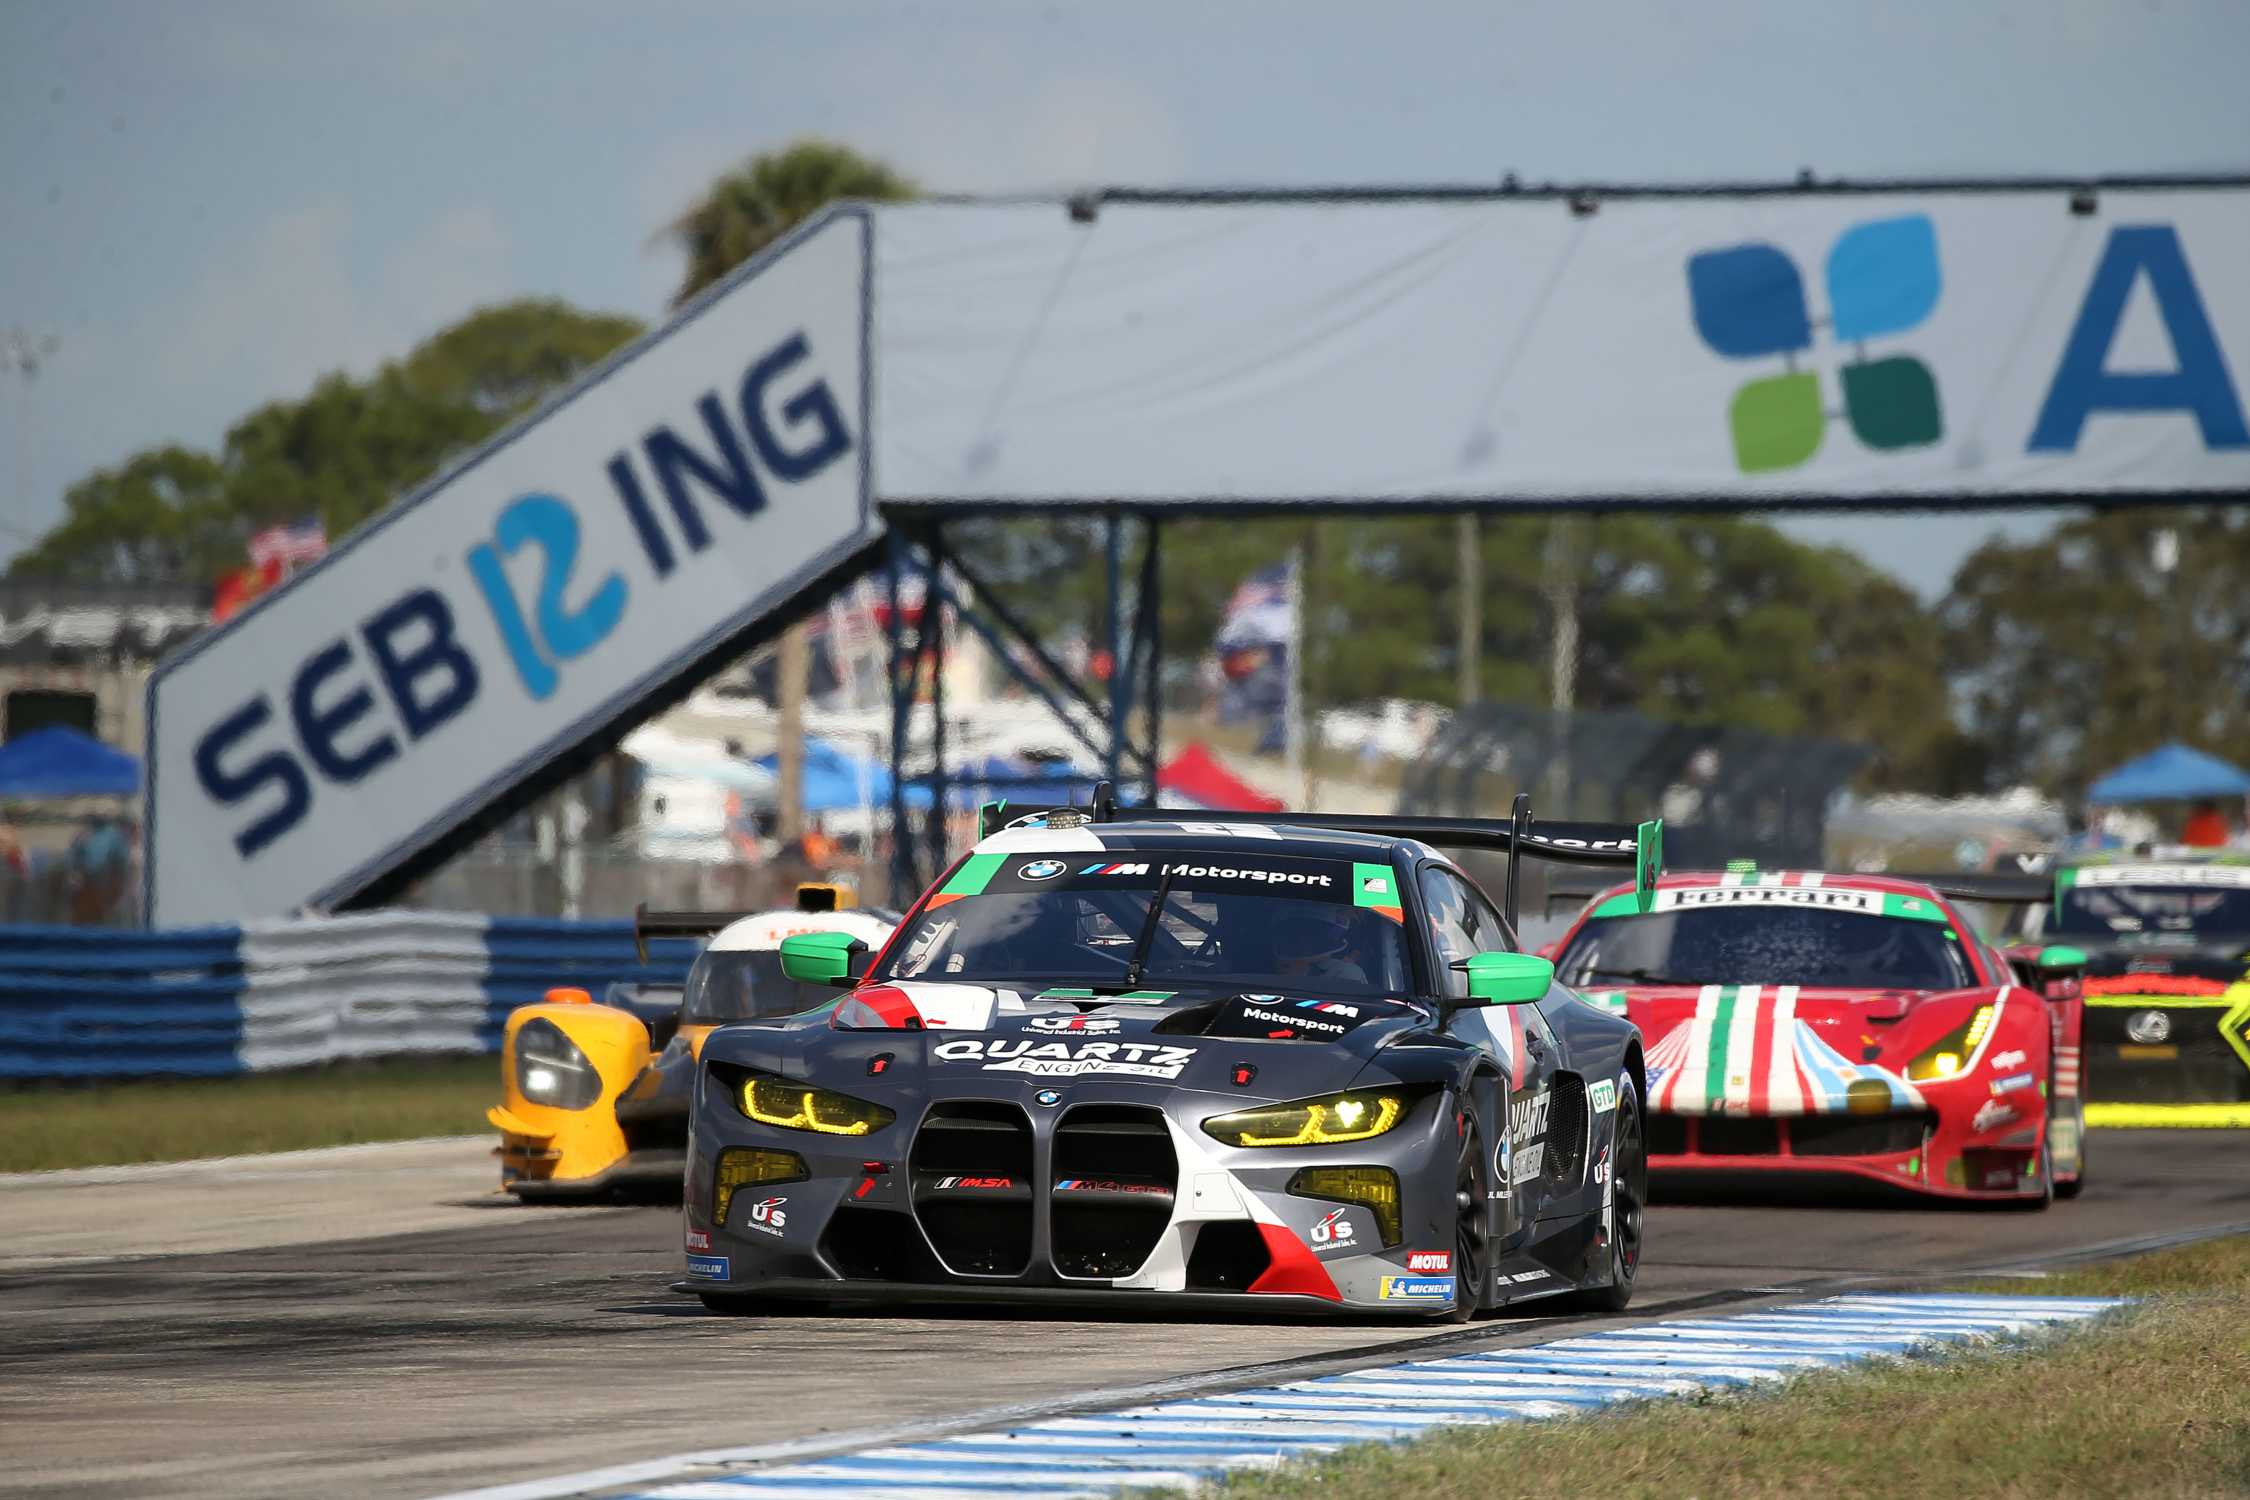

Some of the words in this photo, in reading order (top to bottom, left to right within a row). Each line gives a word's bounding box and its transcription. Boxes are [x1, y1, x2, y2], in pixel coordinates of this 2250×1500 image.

[1160, 863, 1333, 888] Motorsport
[1673, 887, 1870, 909] Ferrari
[1243, 1007, 1345, 1034] Motorsport
[934, 1039, 1198, 1067] QUARTZ
[1592, 1083, 1614, 1107] GTD
[959, 1177, 1014, 1189] IMSA
[1409, 1254, 1449, 1270] MOTUL
[1407, 1284, 1451, 1294] MICHELIN
